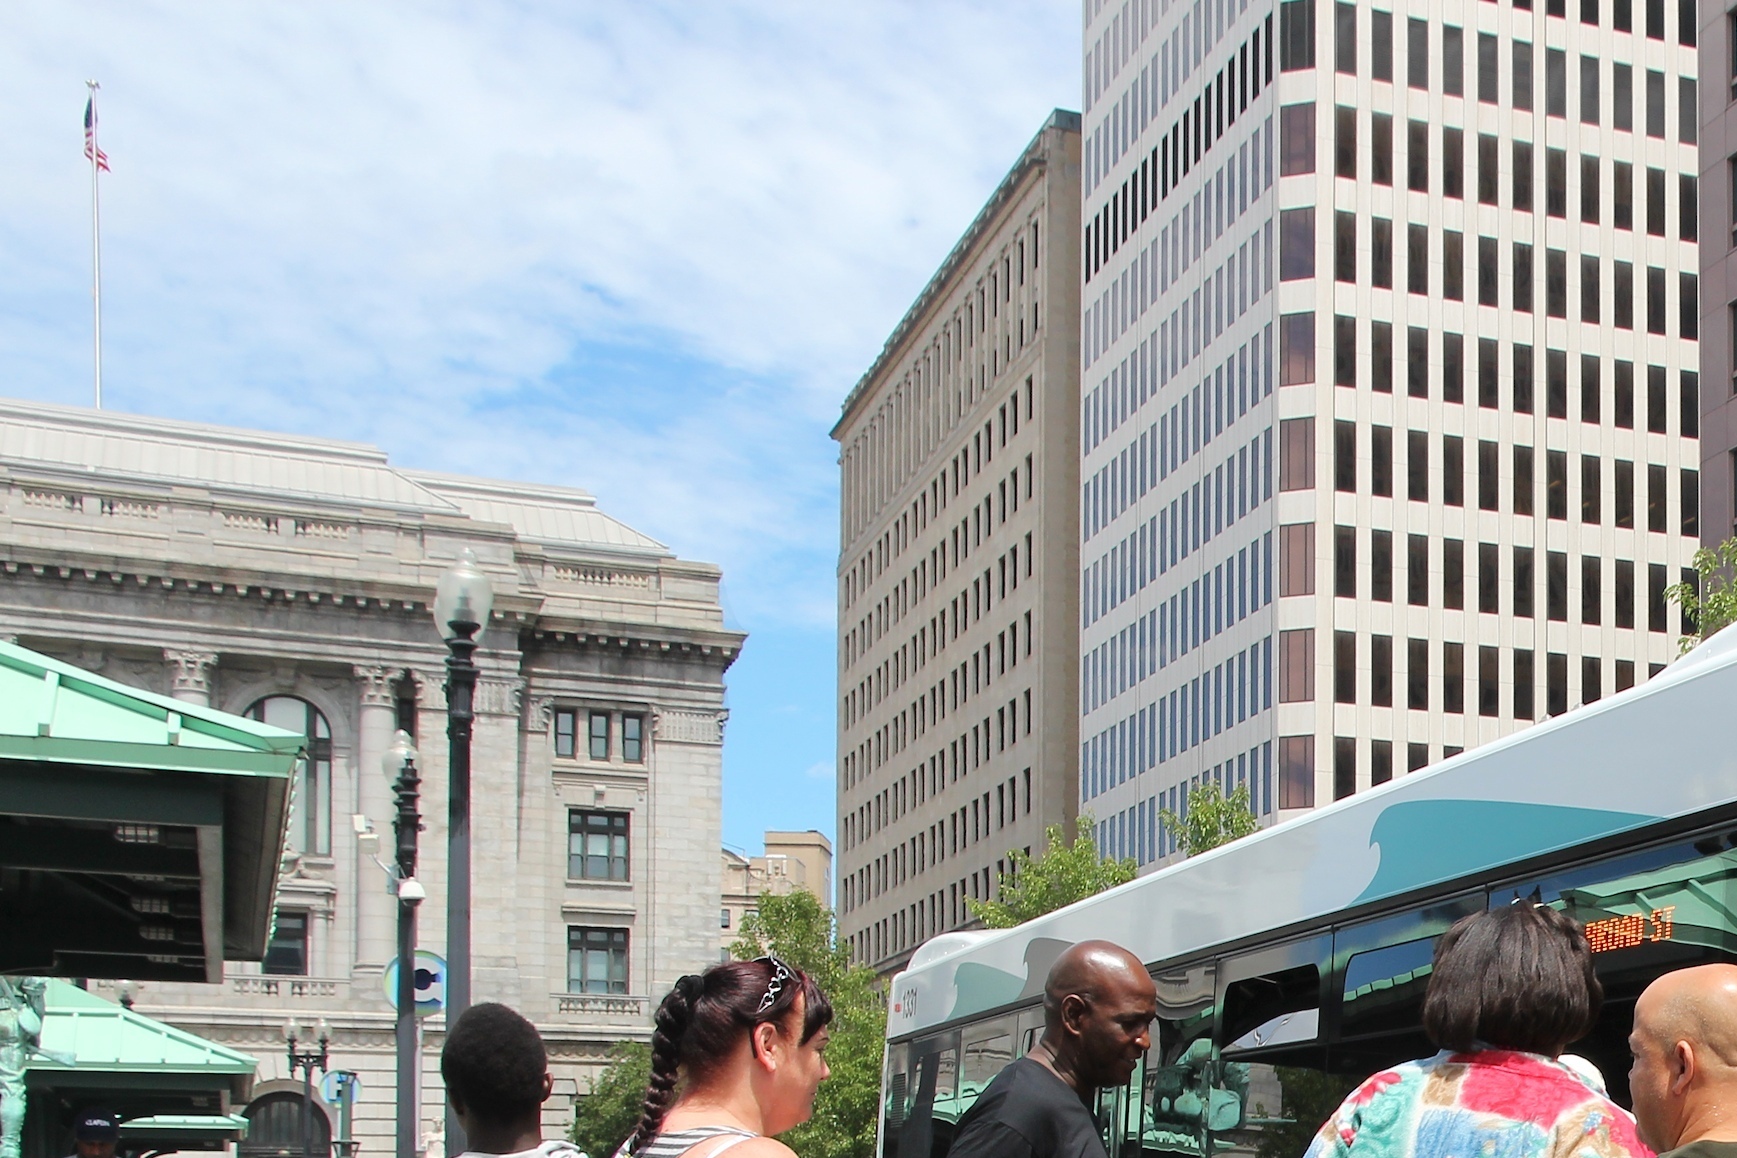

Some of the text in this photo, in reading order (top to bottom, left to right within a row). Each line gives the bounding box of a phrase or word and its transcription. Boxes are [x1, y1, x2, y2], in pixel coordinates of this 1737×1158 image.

[1585, 905, 1676, 954] BROAD ST
[903, 987, 918, 1019] 1331
